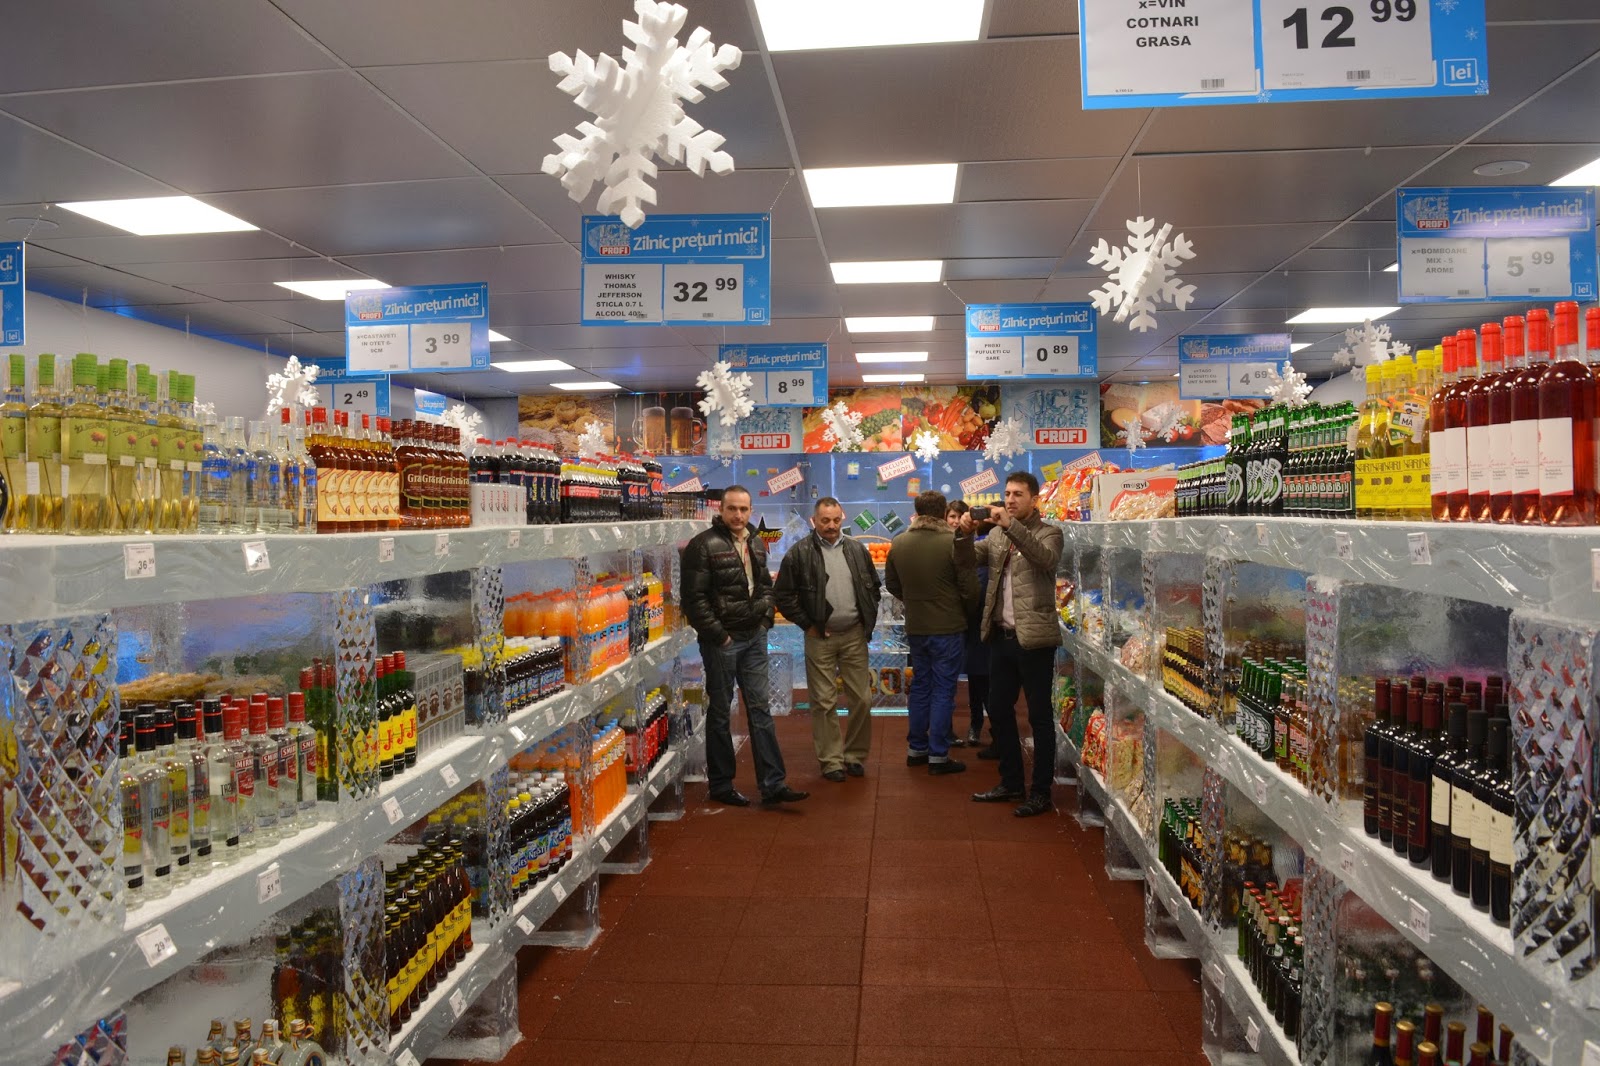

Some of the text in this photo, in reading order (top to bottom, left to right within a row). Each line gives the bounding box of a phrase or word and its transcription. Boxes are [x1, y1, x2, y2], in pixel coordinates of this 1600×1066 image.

[1370, 0, 1417, 23] 99
[1126, 16, 1199, 29] COTNARI
[1282, 6, 1356, 50] 12
[1135, 35, 1192, 48] GRASA
[1451, 62, 1472, 81] lei
[1452, 207, 1491, 225] Zilnic
[1548, 199, 1583, 217] mici!
[633, 235, 670, 251] Zilnic
[724, 227, 759, 245] mici!
[1531, 251, 1555, 265] 99
[1507, 256, 1524, 277] 5
[715, 278, 737, 291] 99
[1578, 285, 1589, 293] lei
[673, 282, 708, 302] 32
[385, 302, 412, 316] Zilnic
[453, 293, 479, 308] mici!
[751, 310, 762, 319] lei
[1002, 317, 1027, 328] Zilnic
[1064, 310, 1088, 323] mici!
[8, 332, 18, 340] lei
[443, 334, 460, 344] 99
[425, 337, 437, 353] 3
[1053, 345, 1068, 354] 89
[1210, 346, 1233, 356] Zilnic
[749, 355, 770, 364] Zilnic
[801, 350, 820, 360] mici!
[1036, 348, 1048, 362] 0
[1240, 373, 1250, 385] 4
[1254, 371, 1268, 379] 69
[778, 382, 787, 393] 8
[344, 393, 353, 404] 2
[744, 435, 786, 448] PROFI
[1039, 430, 1083, 443] PROFI
[881, 458, 909, 473] EXCLUSIV
[1067, 454, 1097, 470] EXCLUSIV
[892, 464, 912, 476] PROFI
[769, 468, 797, 486] EXCLUSIV
[781, 476, 800, 489] PROFI
[963, 472, 992, 488] EXCLUSIV
[966, 478, 994, 494] LA PROFI
[138, 560, 148, 570] 36
